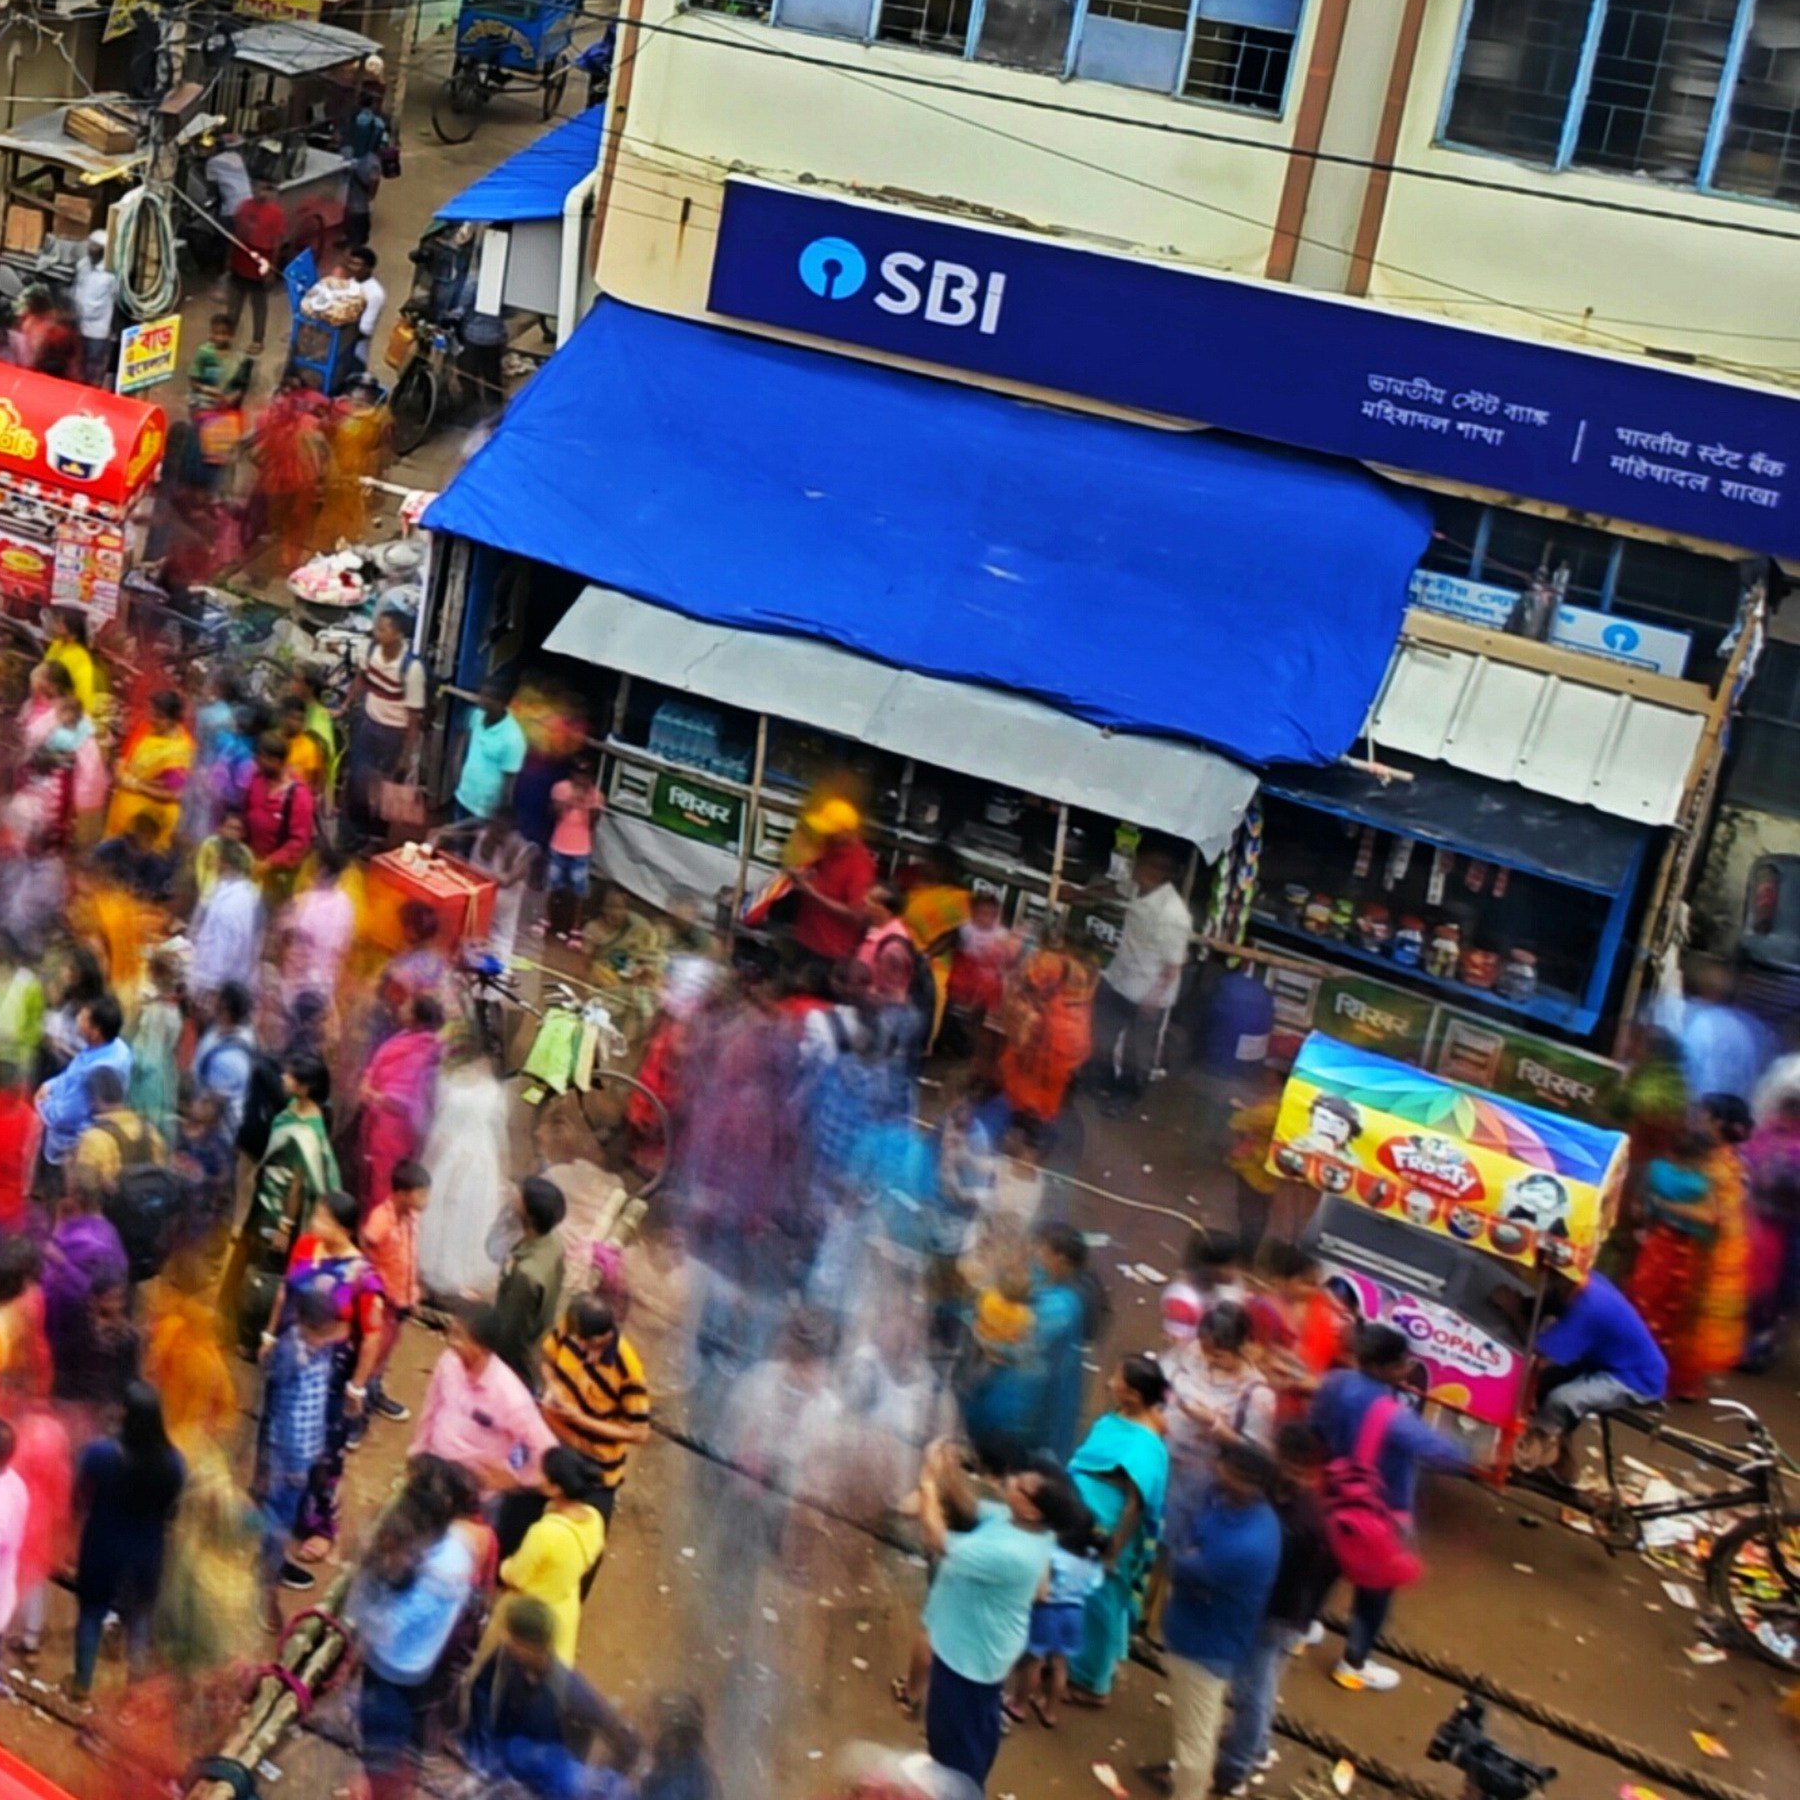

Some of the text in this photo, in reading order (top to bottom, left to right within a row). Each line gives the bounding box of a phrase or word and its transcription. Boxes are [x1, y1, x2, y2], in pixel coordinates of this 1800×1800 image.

[873, 251, 1007, 335] SBI
[1367, 372, 1449, 406] ভারতীয়
[1361, 399, 1506, 447] মহিষাদল শাখা
[1615, 425, 1787, 479] भारतीय स्टेट बैंक
[1719, 475, 1780, 509] शाखा
[668, 784, 731, 824] शिखर
[1334, 991, 1411, 1038] शिखर
[1517, 1057, 1597, 1107] शिखर
